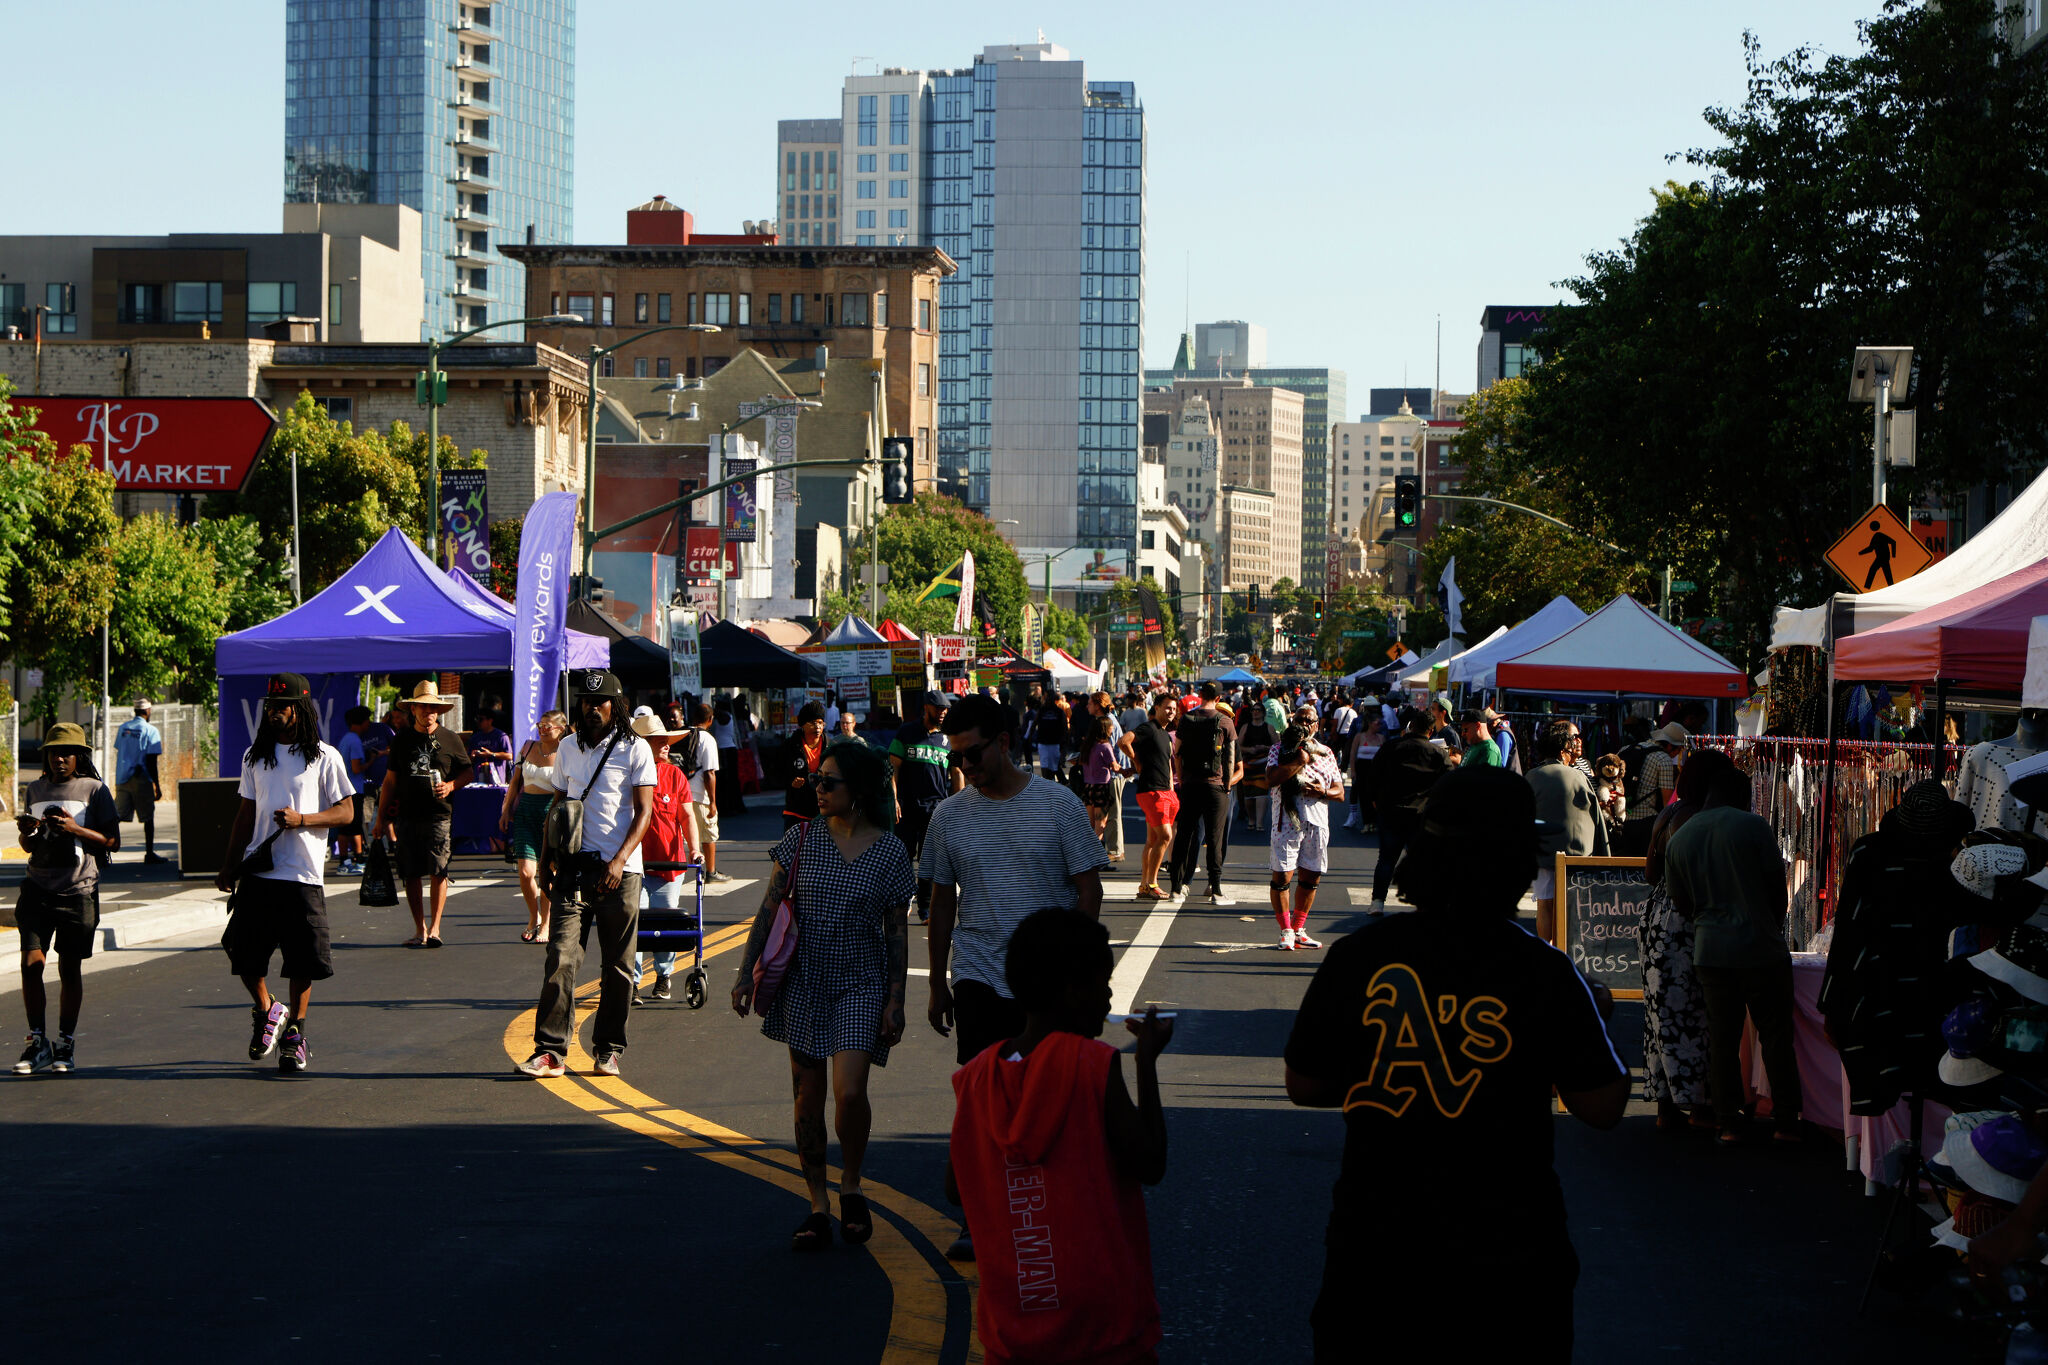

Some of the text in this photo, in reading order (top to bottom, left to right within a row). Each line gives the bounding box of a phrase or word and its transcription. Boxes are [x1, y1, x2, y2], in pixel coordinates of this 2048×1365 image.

[107, 459, 232, 485] MARKET
[727, 473, 756, 517] ONO
[441, 497, 491, 571] KONO
[692, 546, 720, 557] stor
[532, 552, 554, 655] rewards
[936, 638, 966, 648] FUNNEL
[941, 648, 961, 657] CAKE
